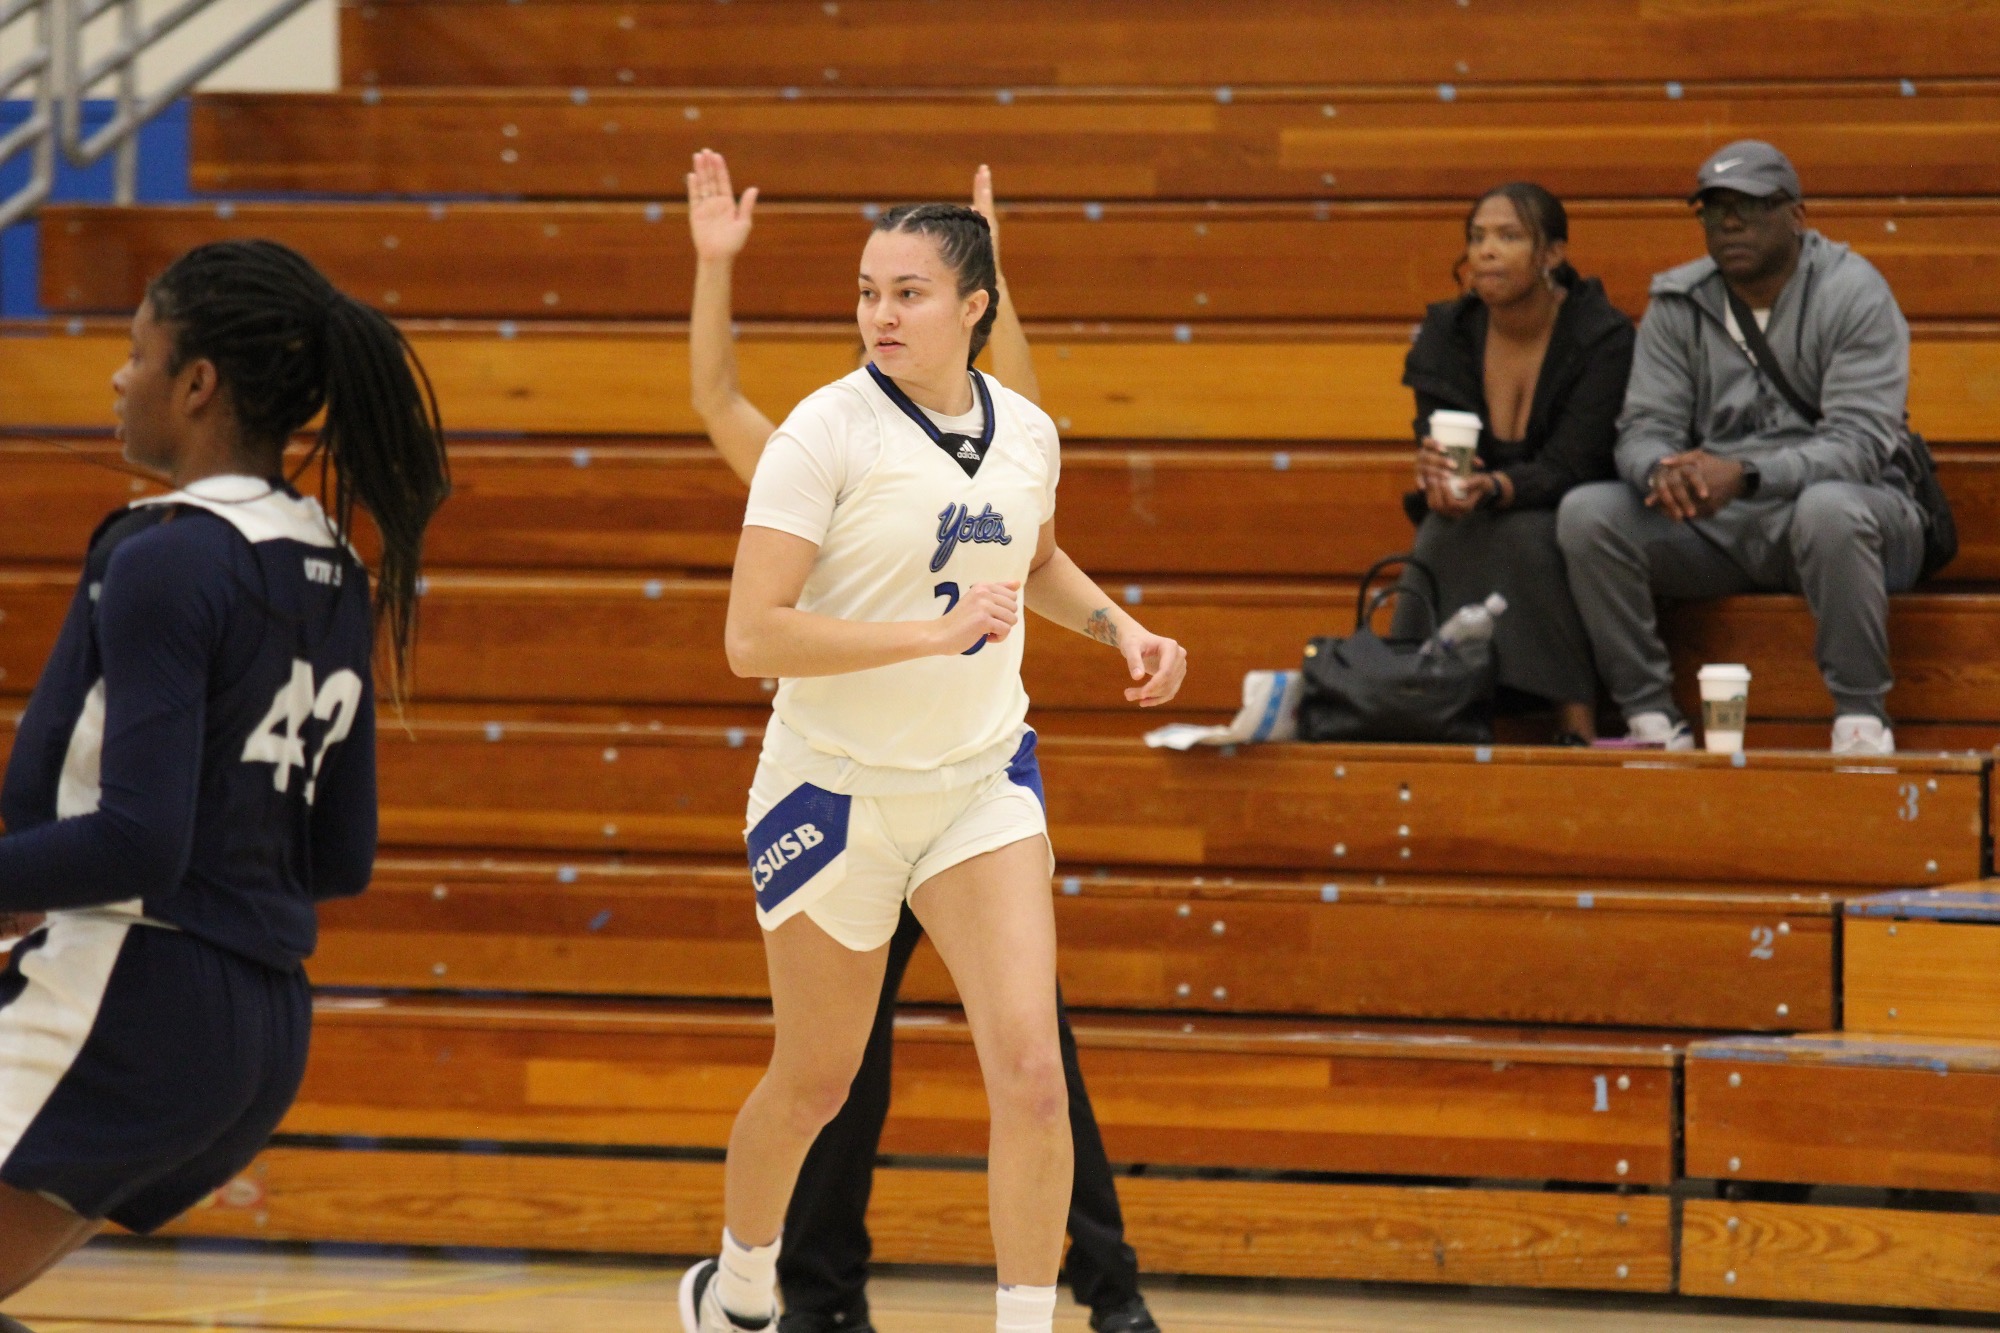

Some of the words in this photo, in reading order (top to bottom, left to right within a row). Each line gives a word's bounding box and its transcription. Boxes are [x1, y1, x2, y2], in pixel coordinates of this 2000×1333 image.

[957, 451, 980, 460] adidas
[929, 502, 1012, 572] Yotes
[1897, 783, 1919, 821] 3
[751, 823, 824, 892] CSUSB
[1750, 926, 1774, 960] 2
[1592, 1074, 1609, 1112] 1
